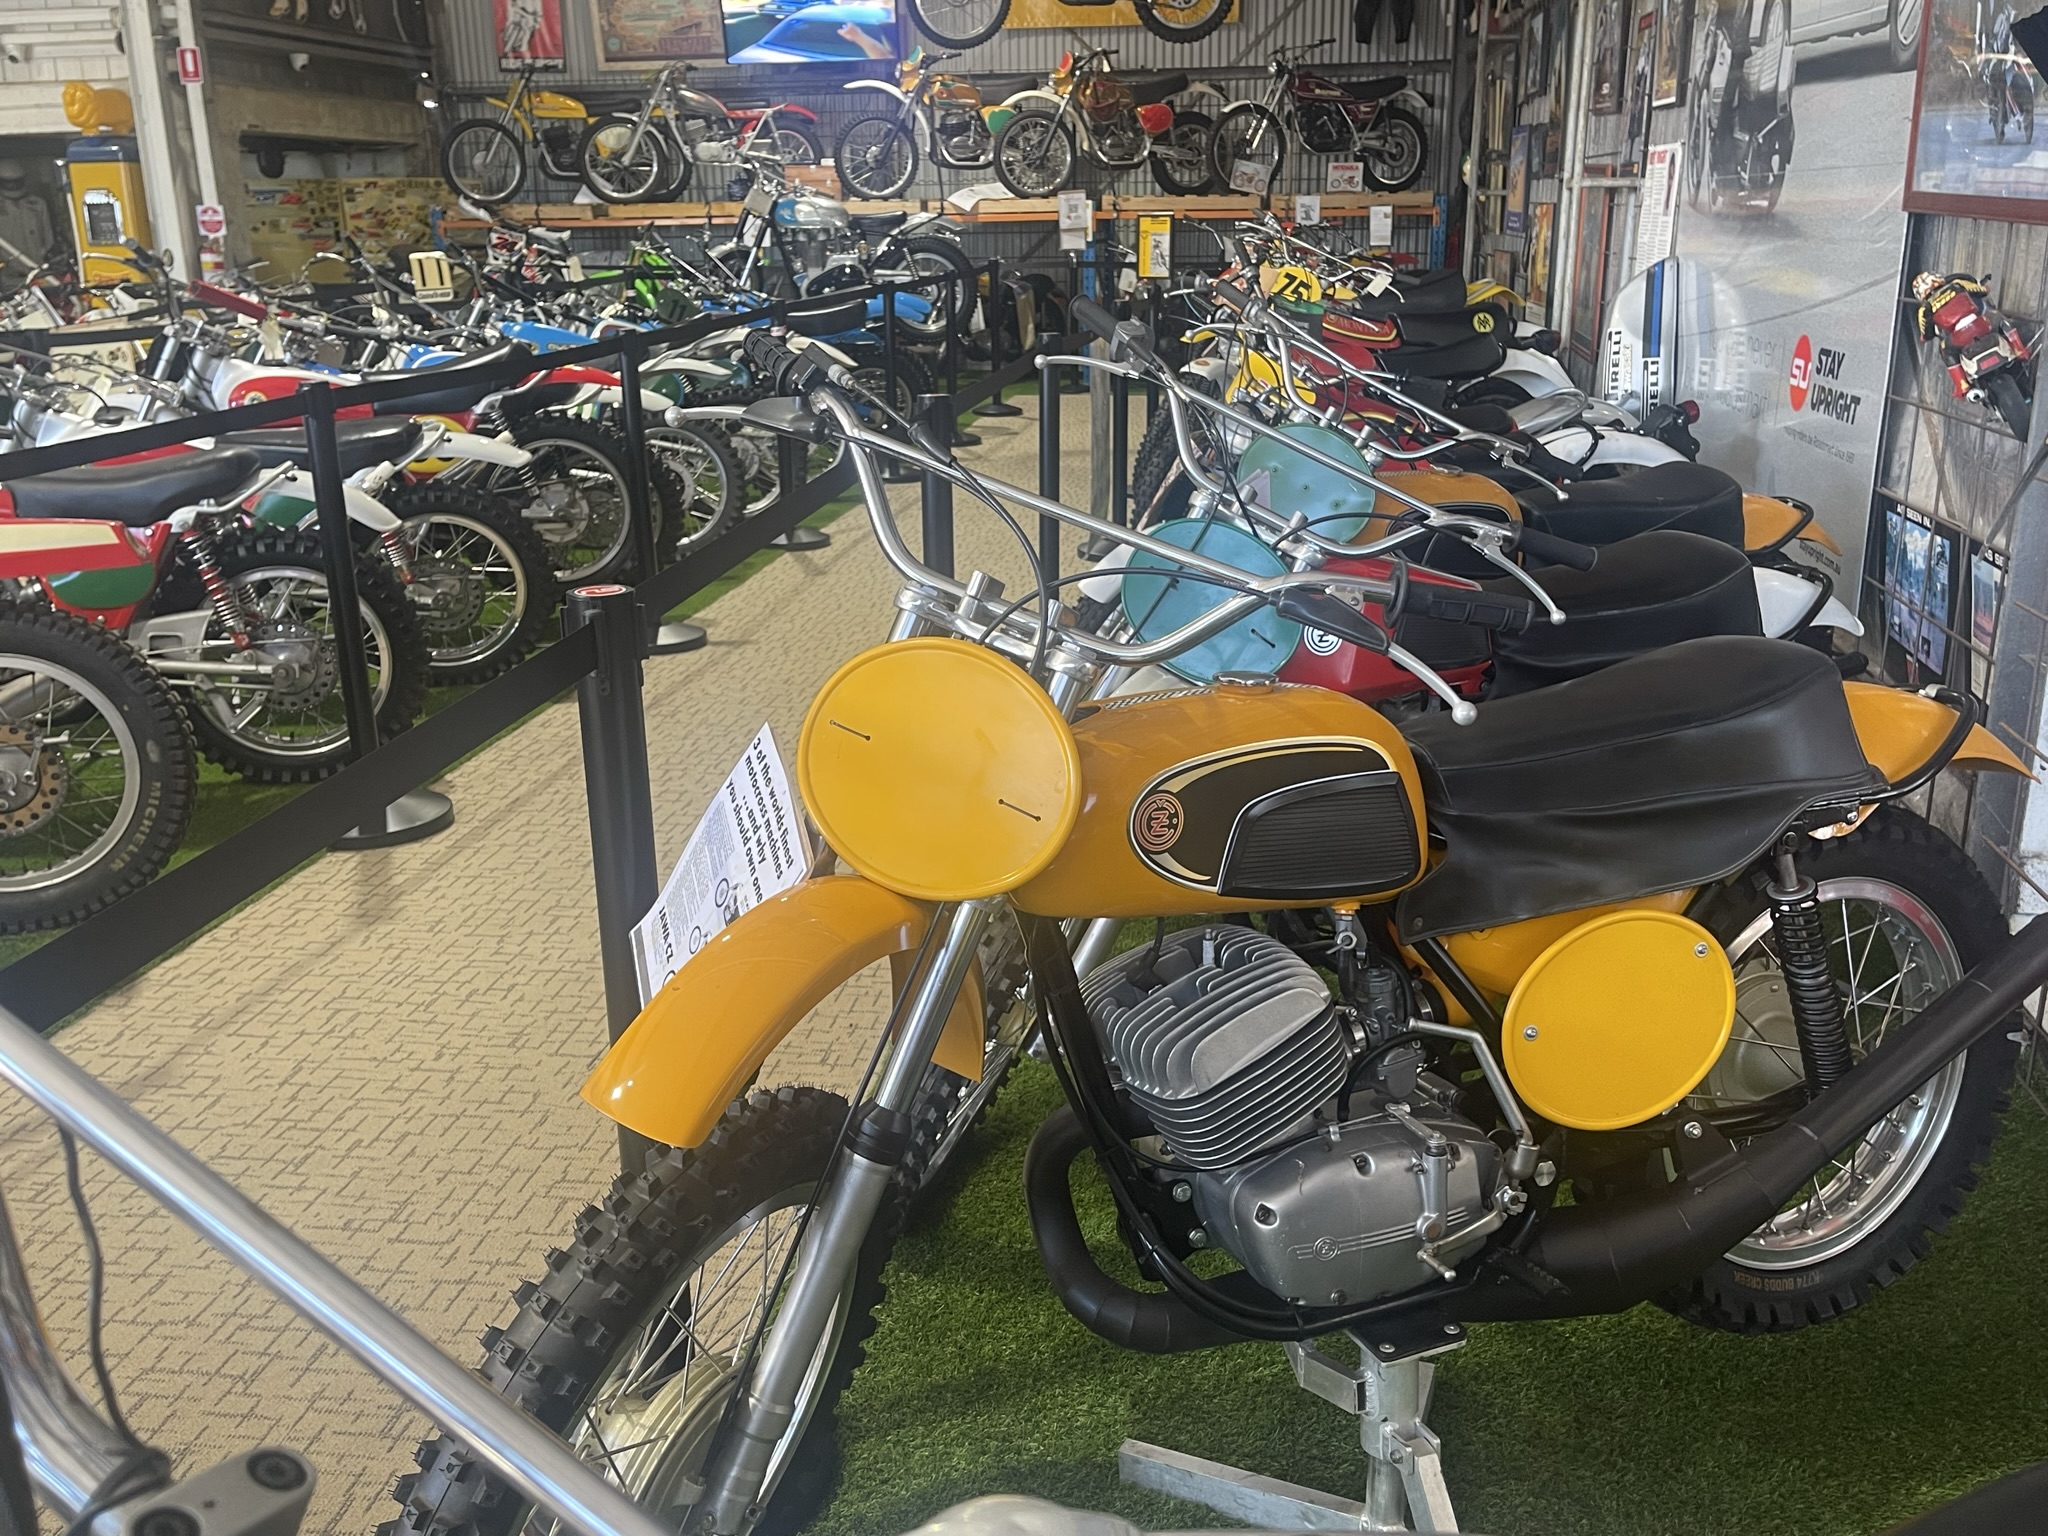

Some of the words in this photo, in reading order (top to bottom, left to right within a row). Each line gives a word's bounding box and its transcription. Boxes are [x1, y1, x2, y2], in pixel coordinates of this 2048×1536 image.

[1815, 347, 1846, 380] STAY
[1810, 383, 1861, 425] UPRIGHT
[753, 737, 761, 750] 3
[756, 750, 767, 762] of
[760, 762, 772, 788] the
[745, 755, 768, 818] motocross
[764, 817, 784, 880] machines
[768, 786, 786, 831] worlds
[110, 781, 162, 872] MICHELIN
[726, 778, 737, 802] you
[733, 804, 752, 847] should
[745, 847, 758, 878] own
[752, 877, 763, 904] one
[755, 836, 767, 865] why
[780, 828, 795, 869] finest
[1733, 1269, 1762, 1290] CREEK
[1764, 1277, 1794, 1292] BUDDS
